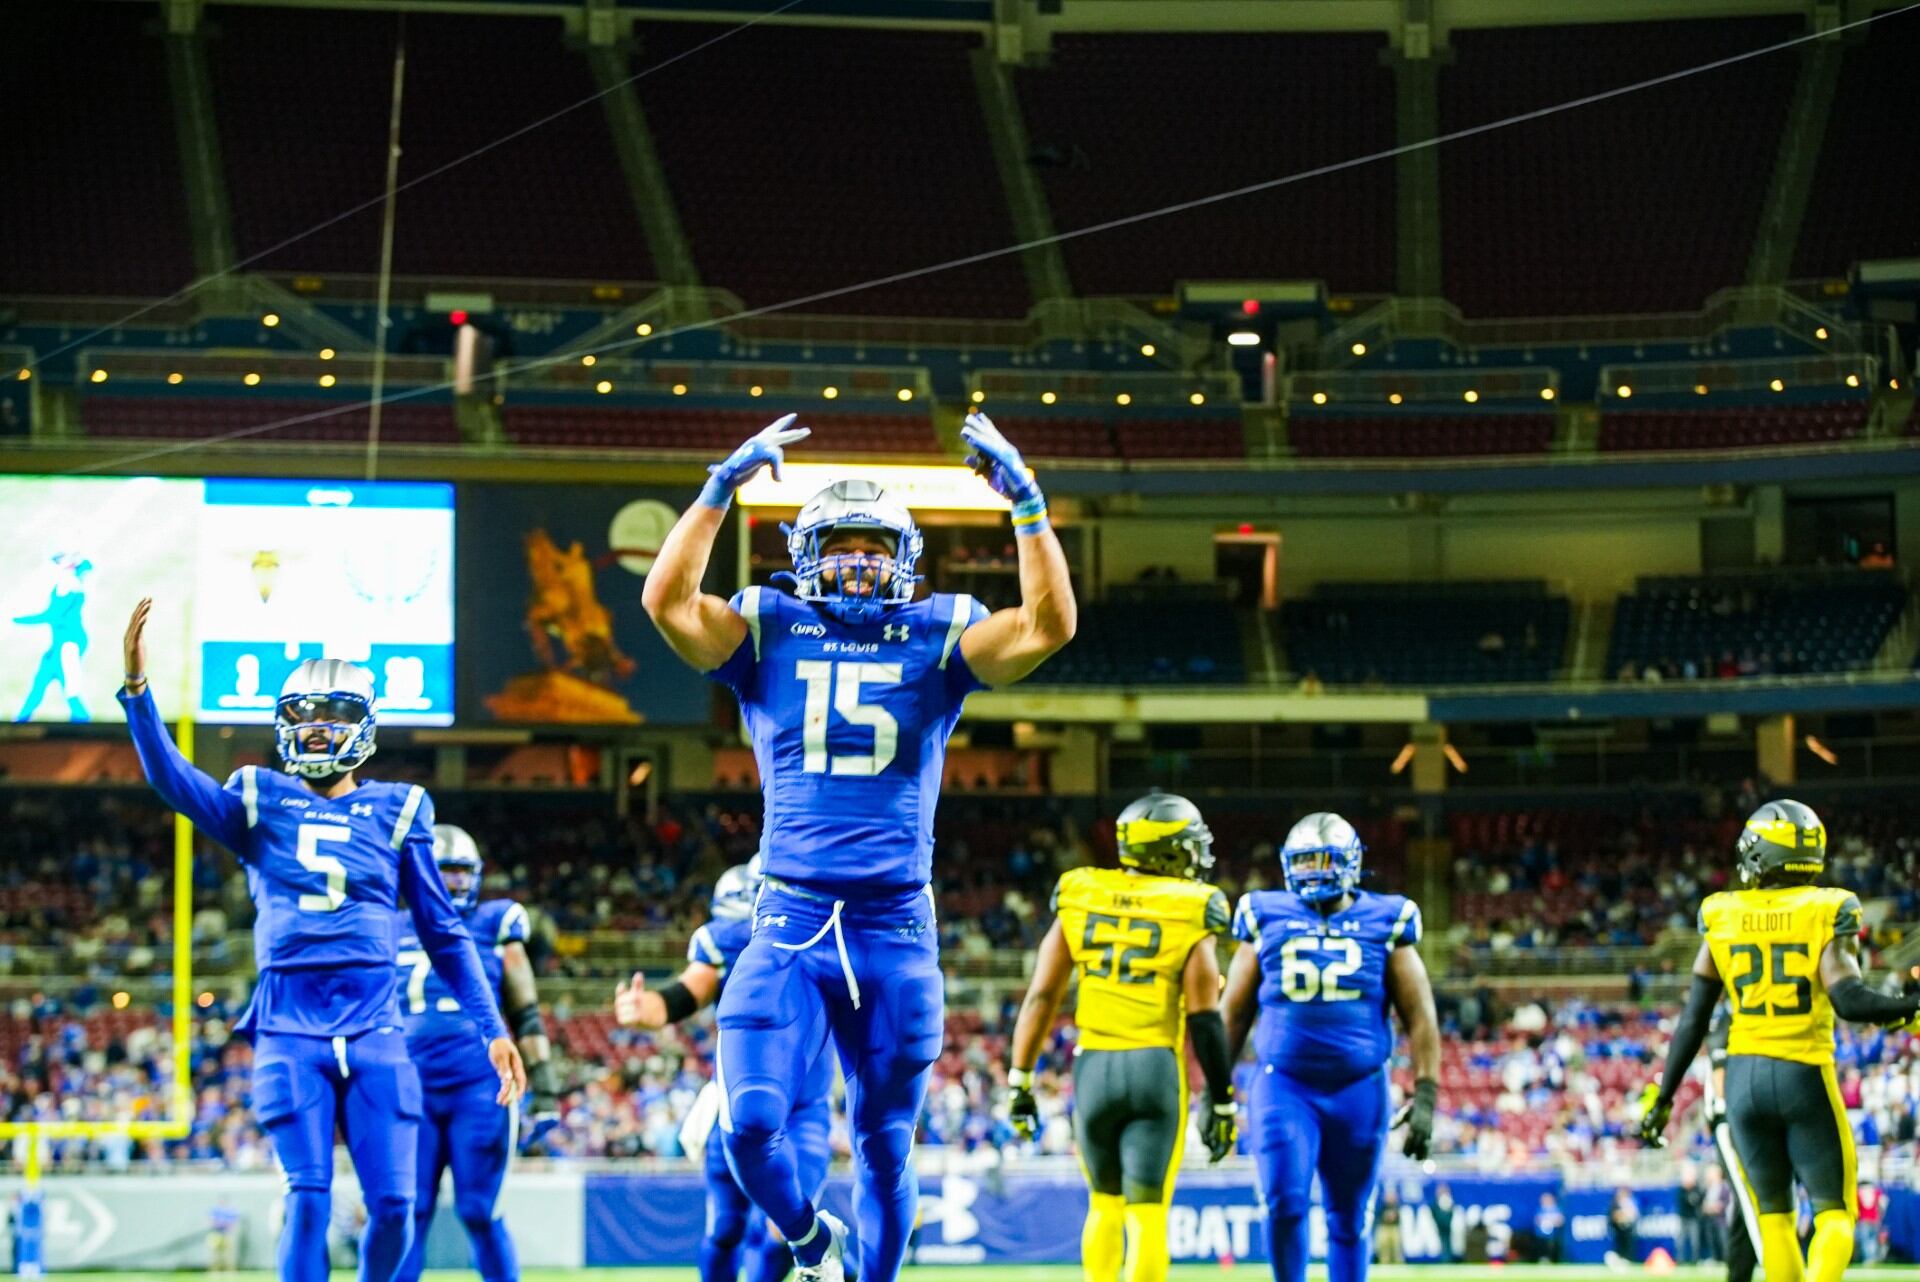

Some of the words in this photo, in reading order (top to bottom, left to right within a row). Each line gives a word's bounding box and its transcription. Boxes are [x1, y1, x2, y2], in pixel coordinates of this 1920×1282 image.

[796, 660, 903, 776] 15
[298, 824, 351, 911] 5
[1081, 913, 1162, 984] 52
[1742, 912, 1792, 932] ELLIOTT
[396, 950, 461, 1014] 7
[1280, 936, 1362, 1002] 62
[1729, 943, 1812, 1016] 25
